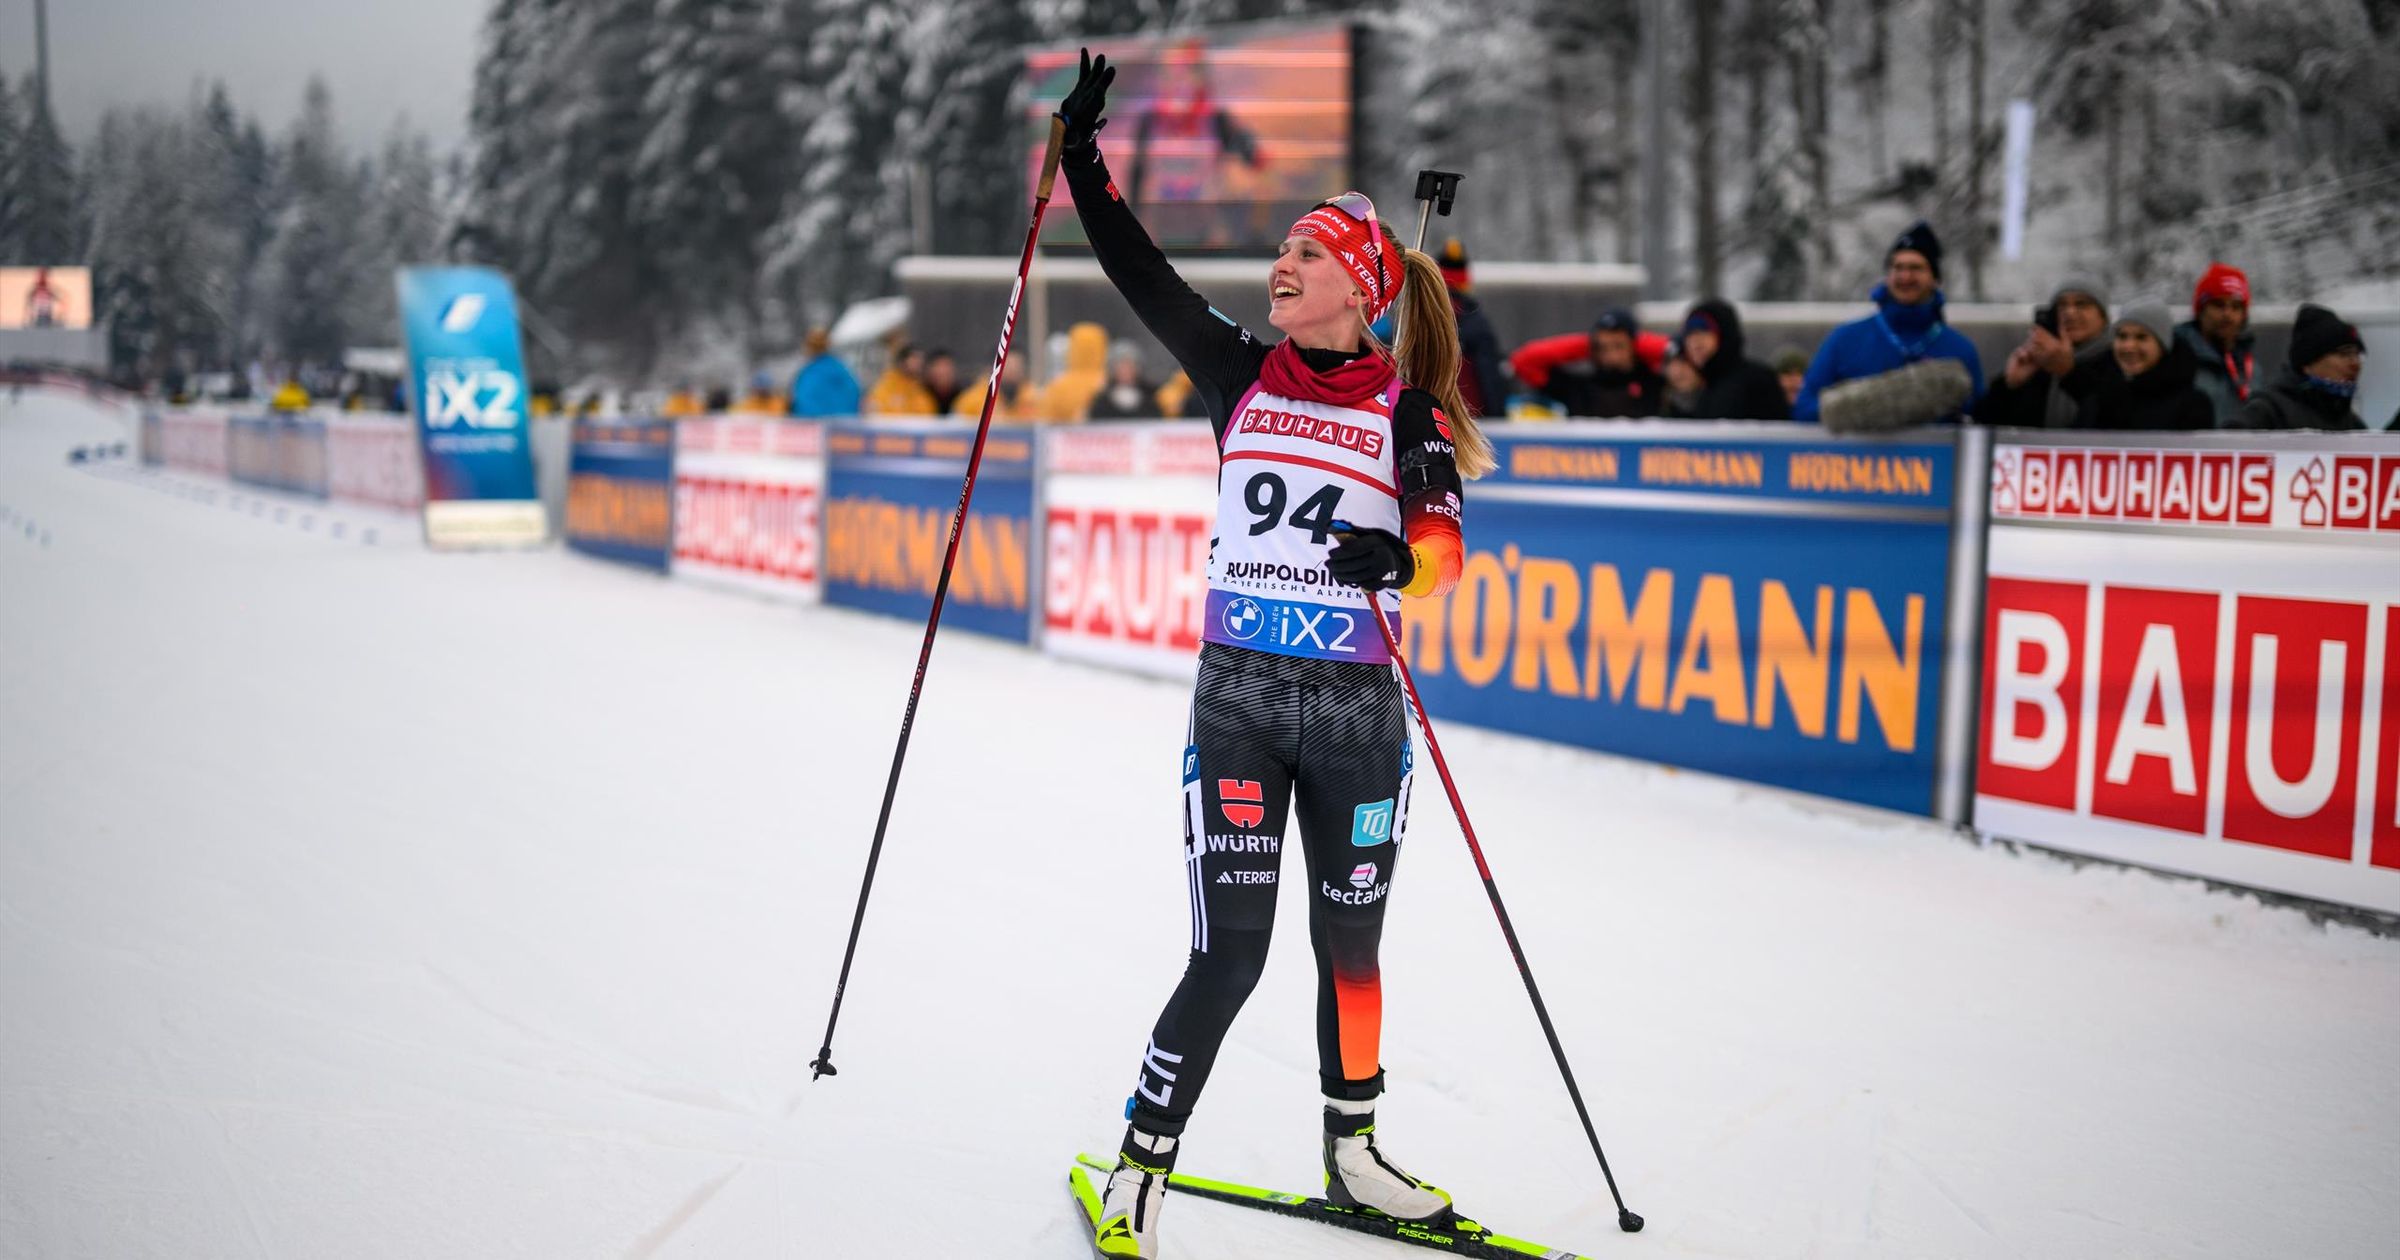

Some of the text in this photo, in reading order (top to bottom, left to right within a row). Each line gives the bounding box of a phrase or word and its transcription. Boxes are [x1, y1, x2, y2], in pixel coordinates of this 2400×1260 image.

[1302, 210, 1351, 233] MANN
[1242, 410, 1382, 456] BAUHAUS
[1640, 445, 1763, 488] HÖRMANN
[1789, 449, 1933, 496] HÖRMANN
[2022, 456, 2272, 517] BAUHAUS
[1243, 471, 1345, 545] 94
[1046, 513, 1206, 648] BAUH
[1225, 562, 1361, 589] RUHPOLDIN
[1316, 588, 1362, 599] ALPEN
[1269, 606, 1279, 643] THE NEW
[1280, 606, 1357, 653] iX2
[1990, 608, 2400, 828] BAU
[1361, 806, 1387, 839] TQ
[1207, 834, 1279, 853] WÜRTH
[1233, 871, 1277, 885] TERREX
[1321, 880, 1388, 905] tectake
[1119, 1151, 1168, 1176] FISCHER
[1397, 1226, 1454, 1246] FISCHER
